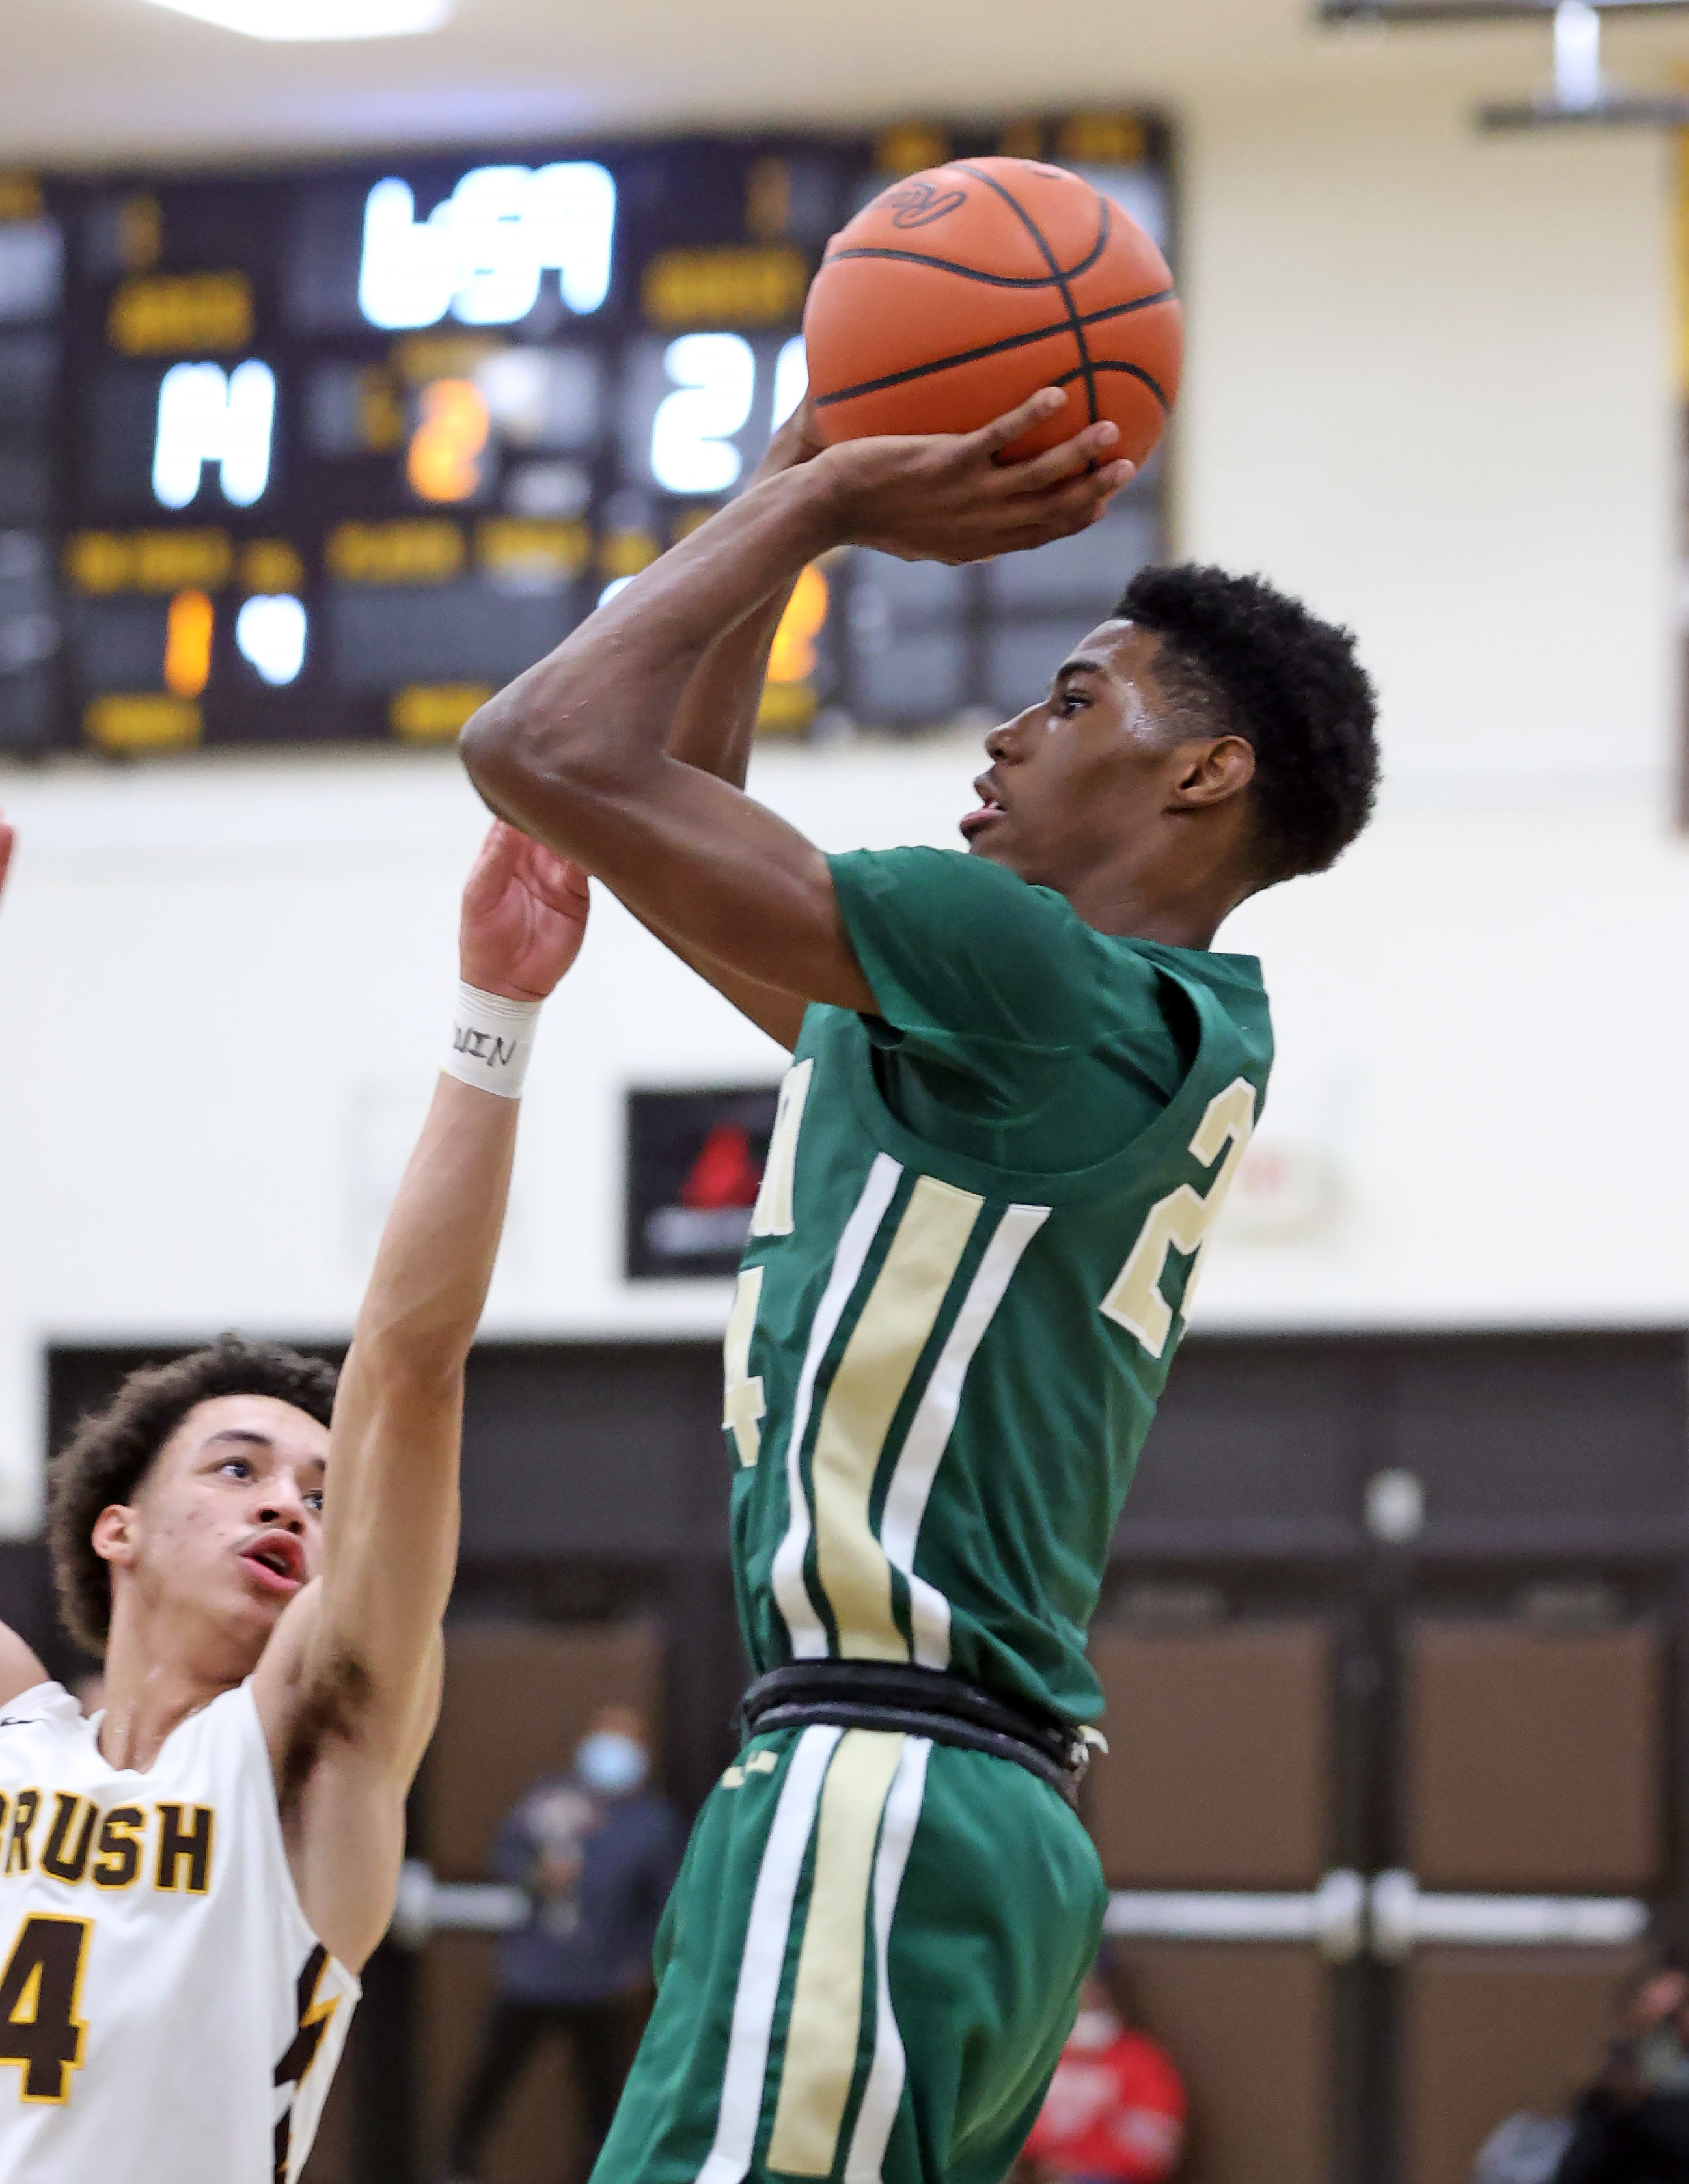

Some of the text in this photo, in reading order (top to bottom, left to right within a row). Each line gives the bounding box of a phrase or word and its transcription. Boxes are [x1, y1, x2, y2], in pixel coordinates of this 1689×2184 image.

[1099, 1076, 1257, 1359] 2
[0, 1786, 215, 1895] RUSH
[0, 1911, 95, 2105] 4
